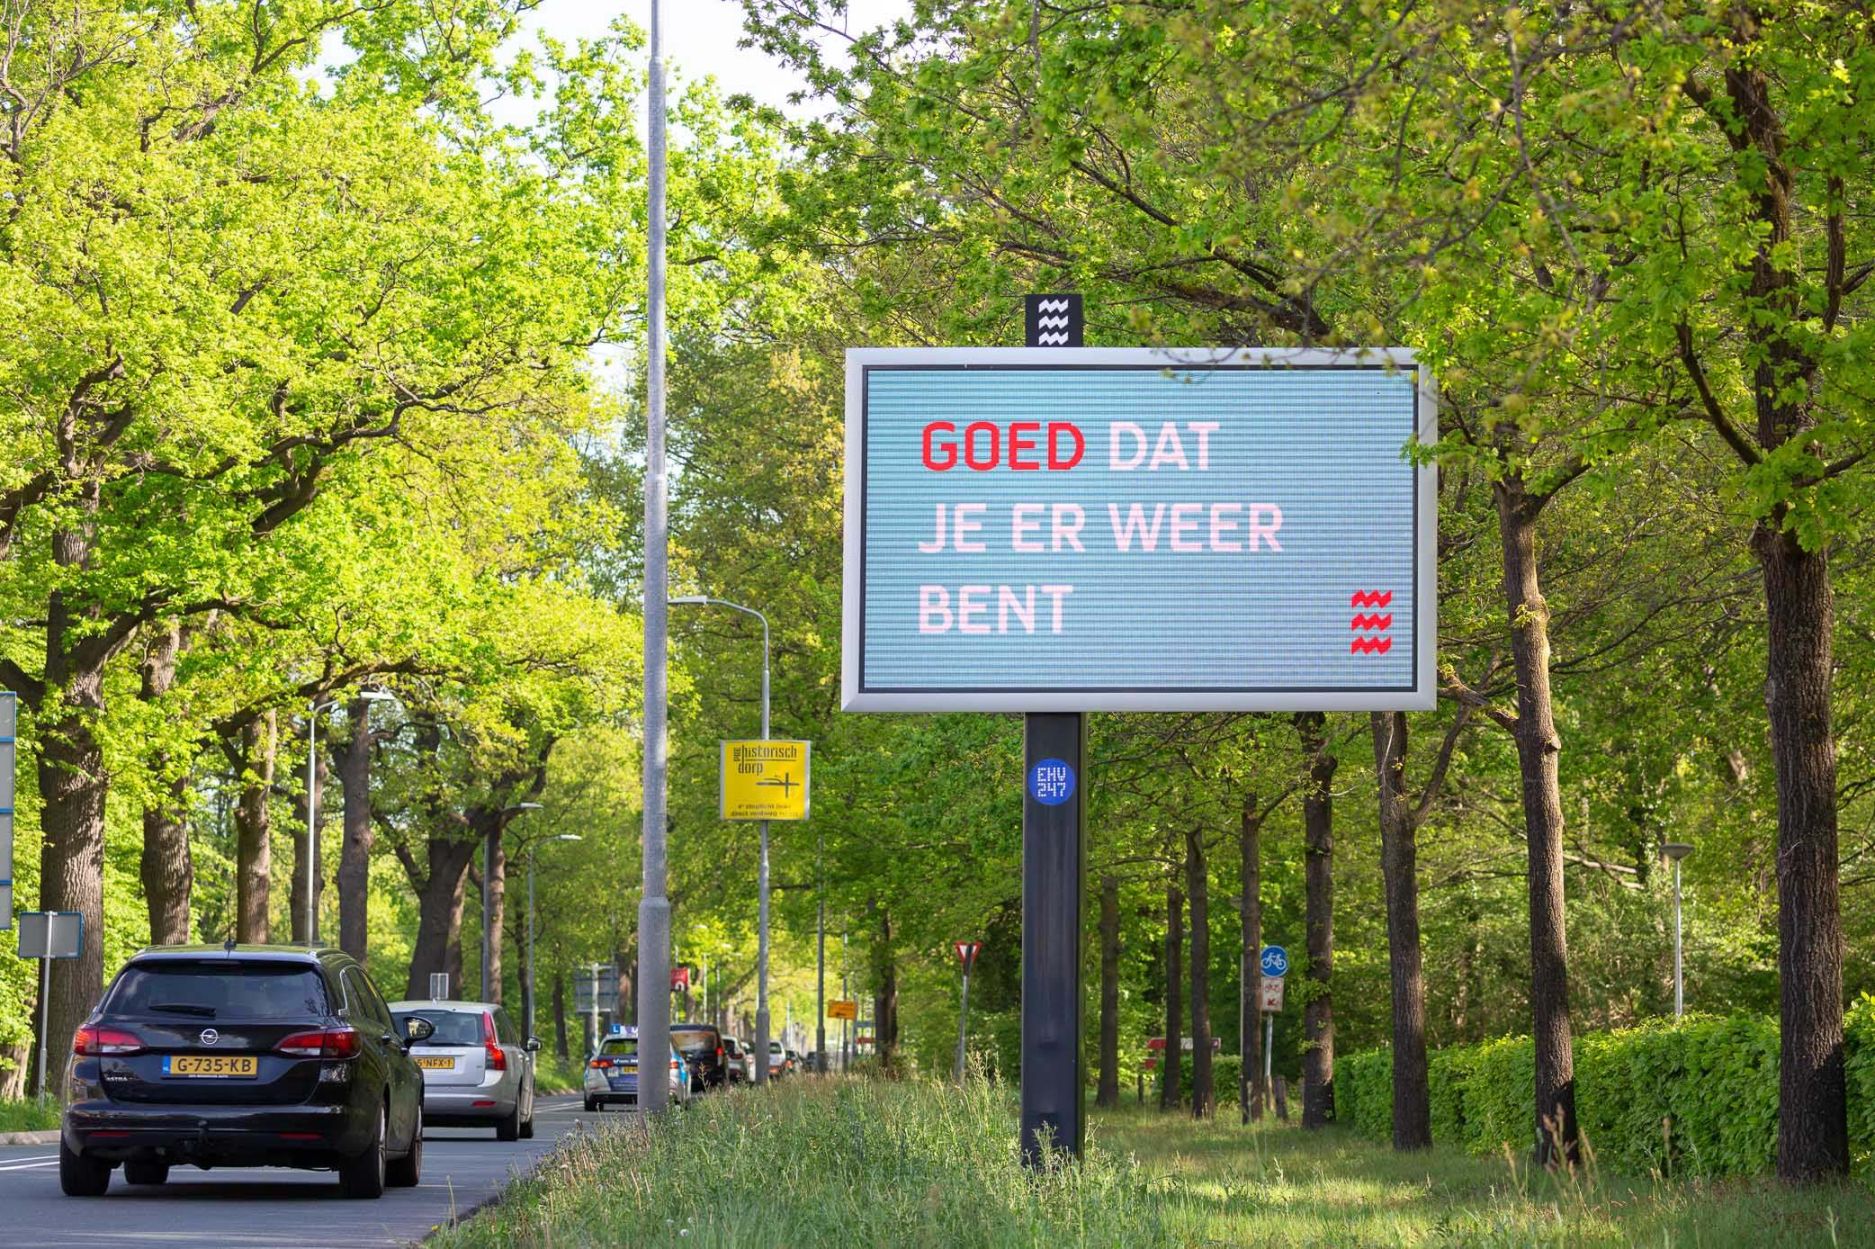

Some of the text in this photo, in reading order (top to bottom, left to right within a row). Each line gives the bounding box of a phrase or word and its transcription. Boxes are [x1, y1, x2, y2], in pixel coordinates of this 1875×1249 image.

[921, 421, 1220, 472] GOED DAT
[918, 503, 1284, 553] JE ER WEER
[918, 585, 1073, 634] BENT
[742, 744, 797, 759] historisch
[738, 762, 763, 776] dorp
[1037, 767, 1066, 782] EHV
[1037, 782, 1066, 797] 247
[613, 1025, 619, 1033] L
[177, 1057, 252, 1073] G-735-KB
[416, 1057, 452, 1068] 5-NFX-1
